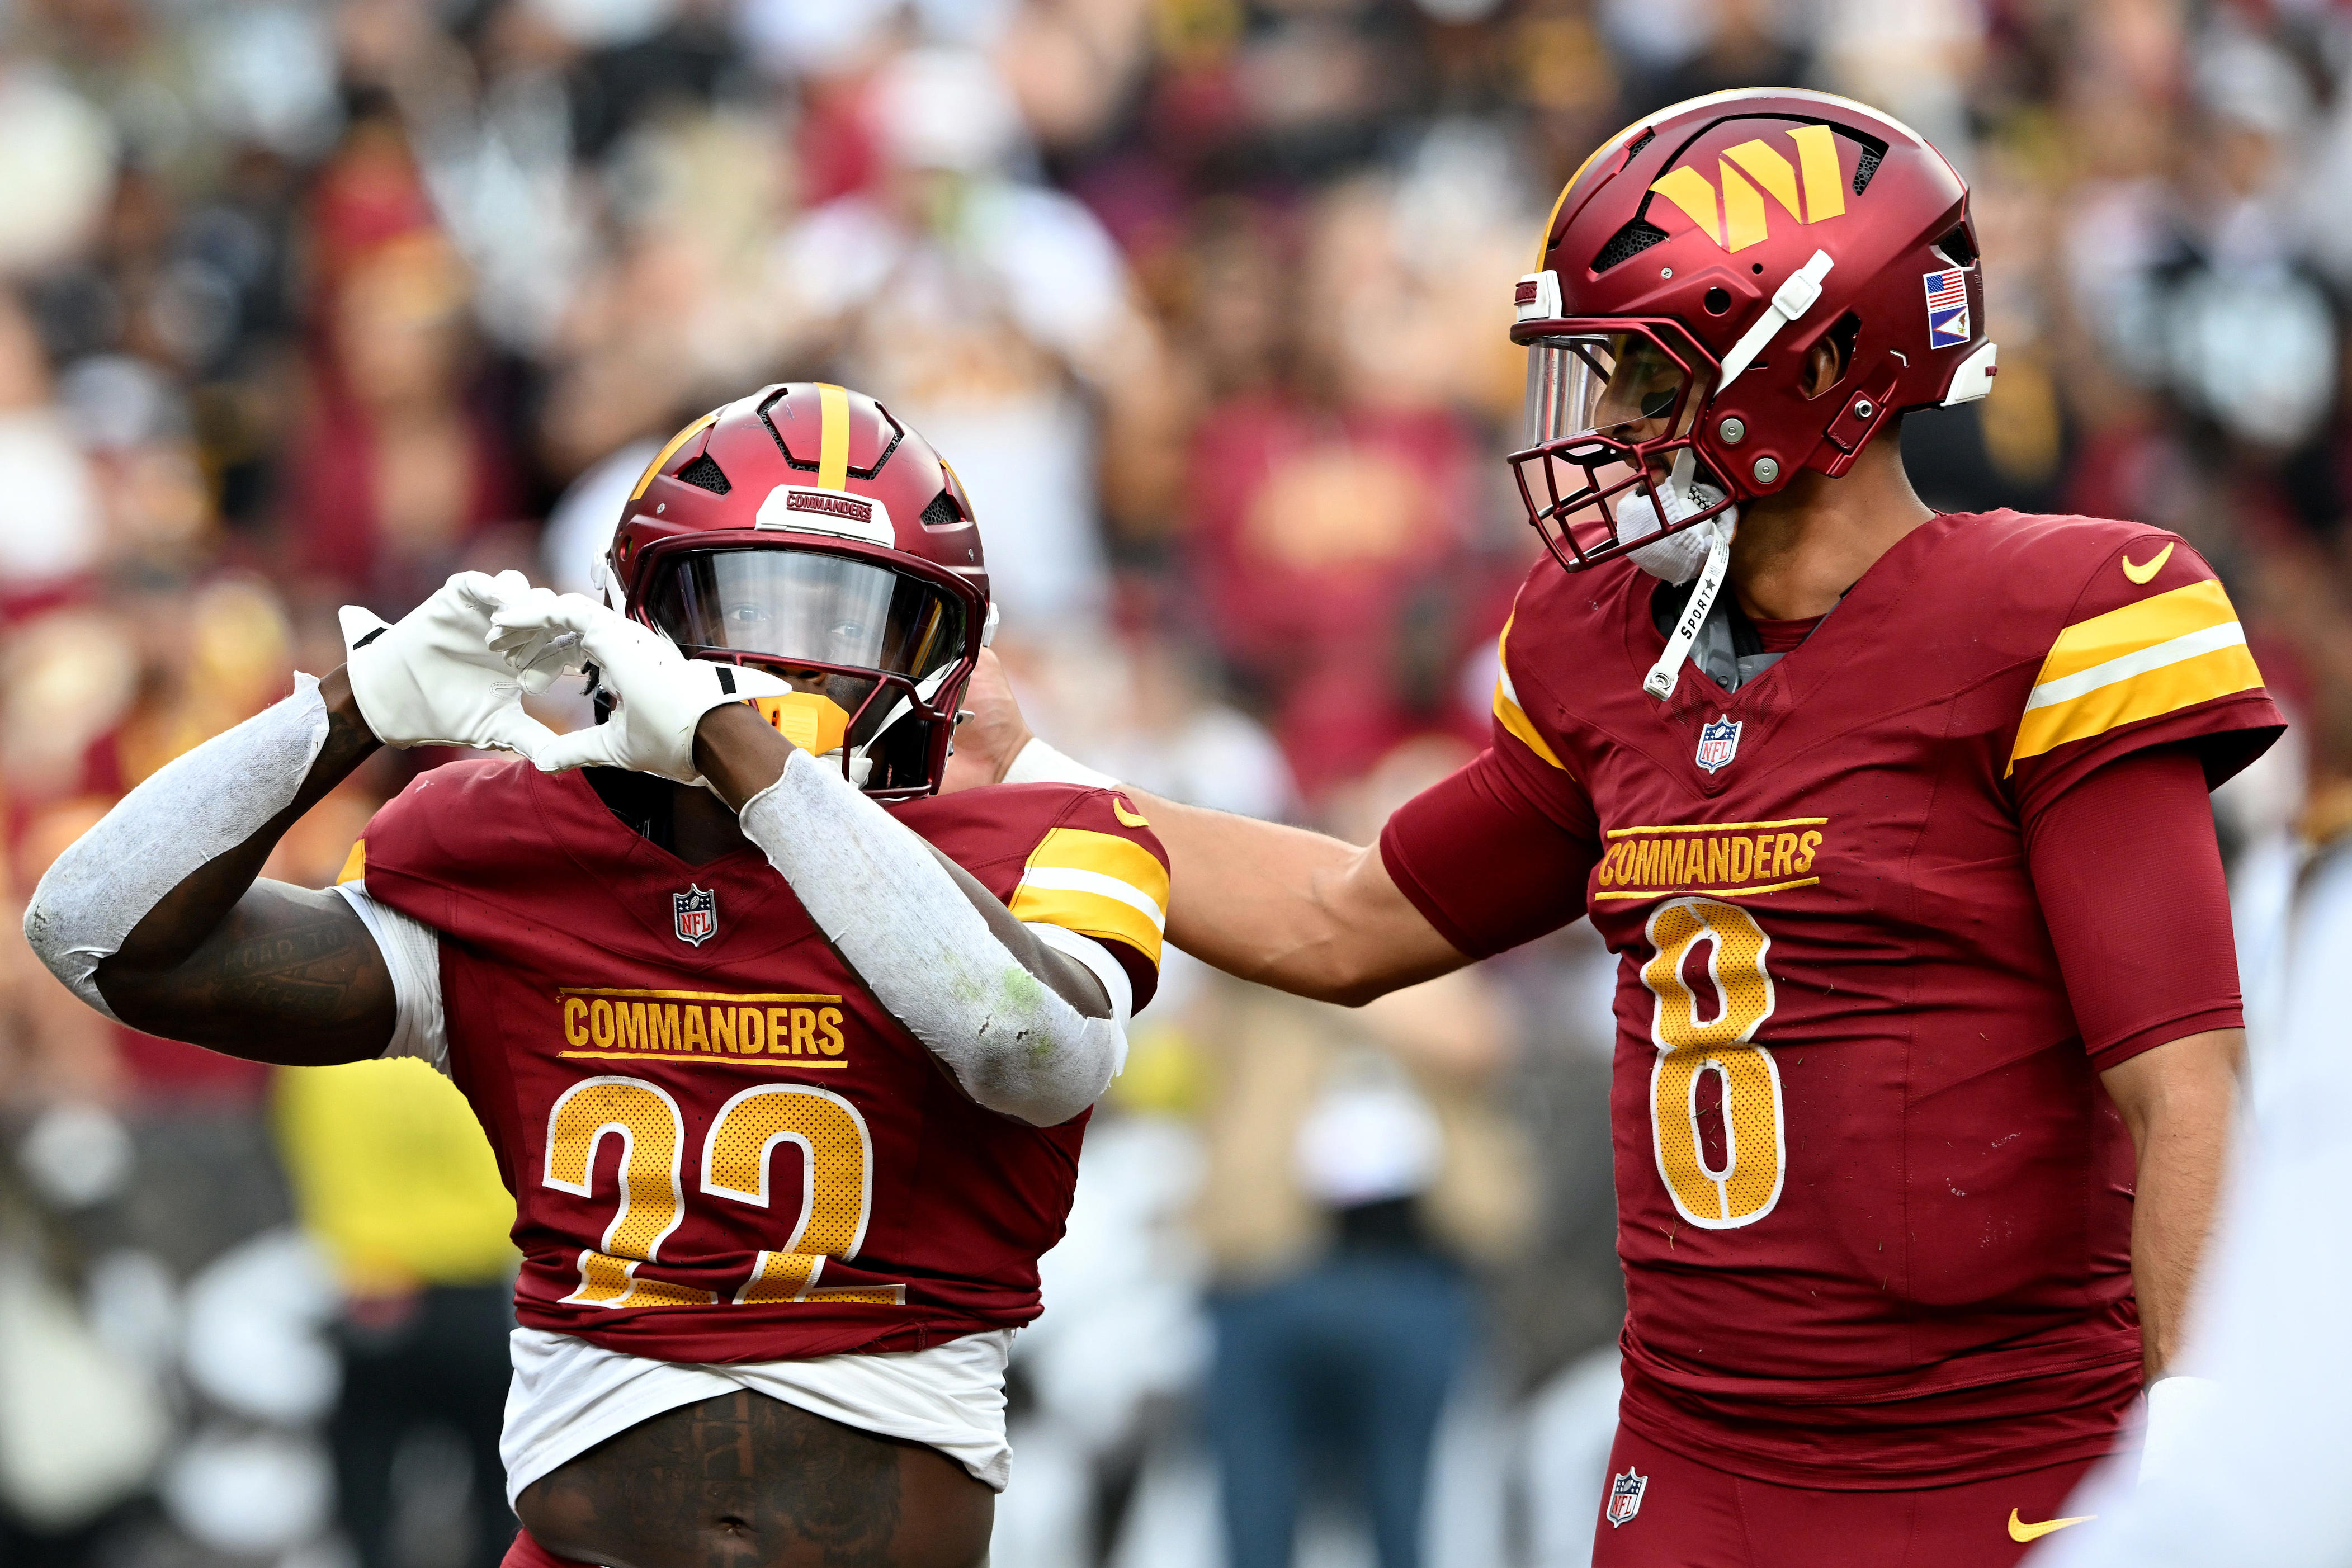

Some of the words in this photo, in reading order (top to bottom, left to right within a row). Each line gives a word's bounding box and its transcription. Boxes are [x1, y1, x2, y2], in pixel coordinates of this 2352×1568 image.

[787, 494, 872, 520] COMMANDERS
[1680, 589, 1711, 640] SPORT
[1702, 742, 1727, 763] NFL
[1599, 829, 1824, 886] COMMANDERS
[681, 912, 711, 936] NFL
[564, 997, 844, 1056] COMMANDERS
[1640, 896, 1786, 1230] 8
[541, 1075, 906, 1309] 22
[1612, 1495, 1632, 1517] NFL
